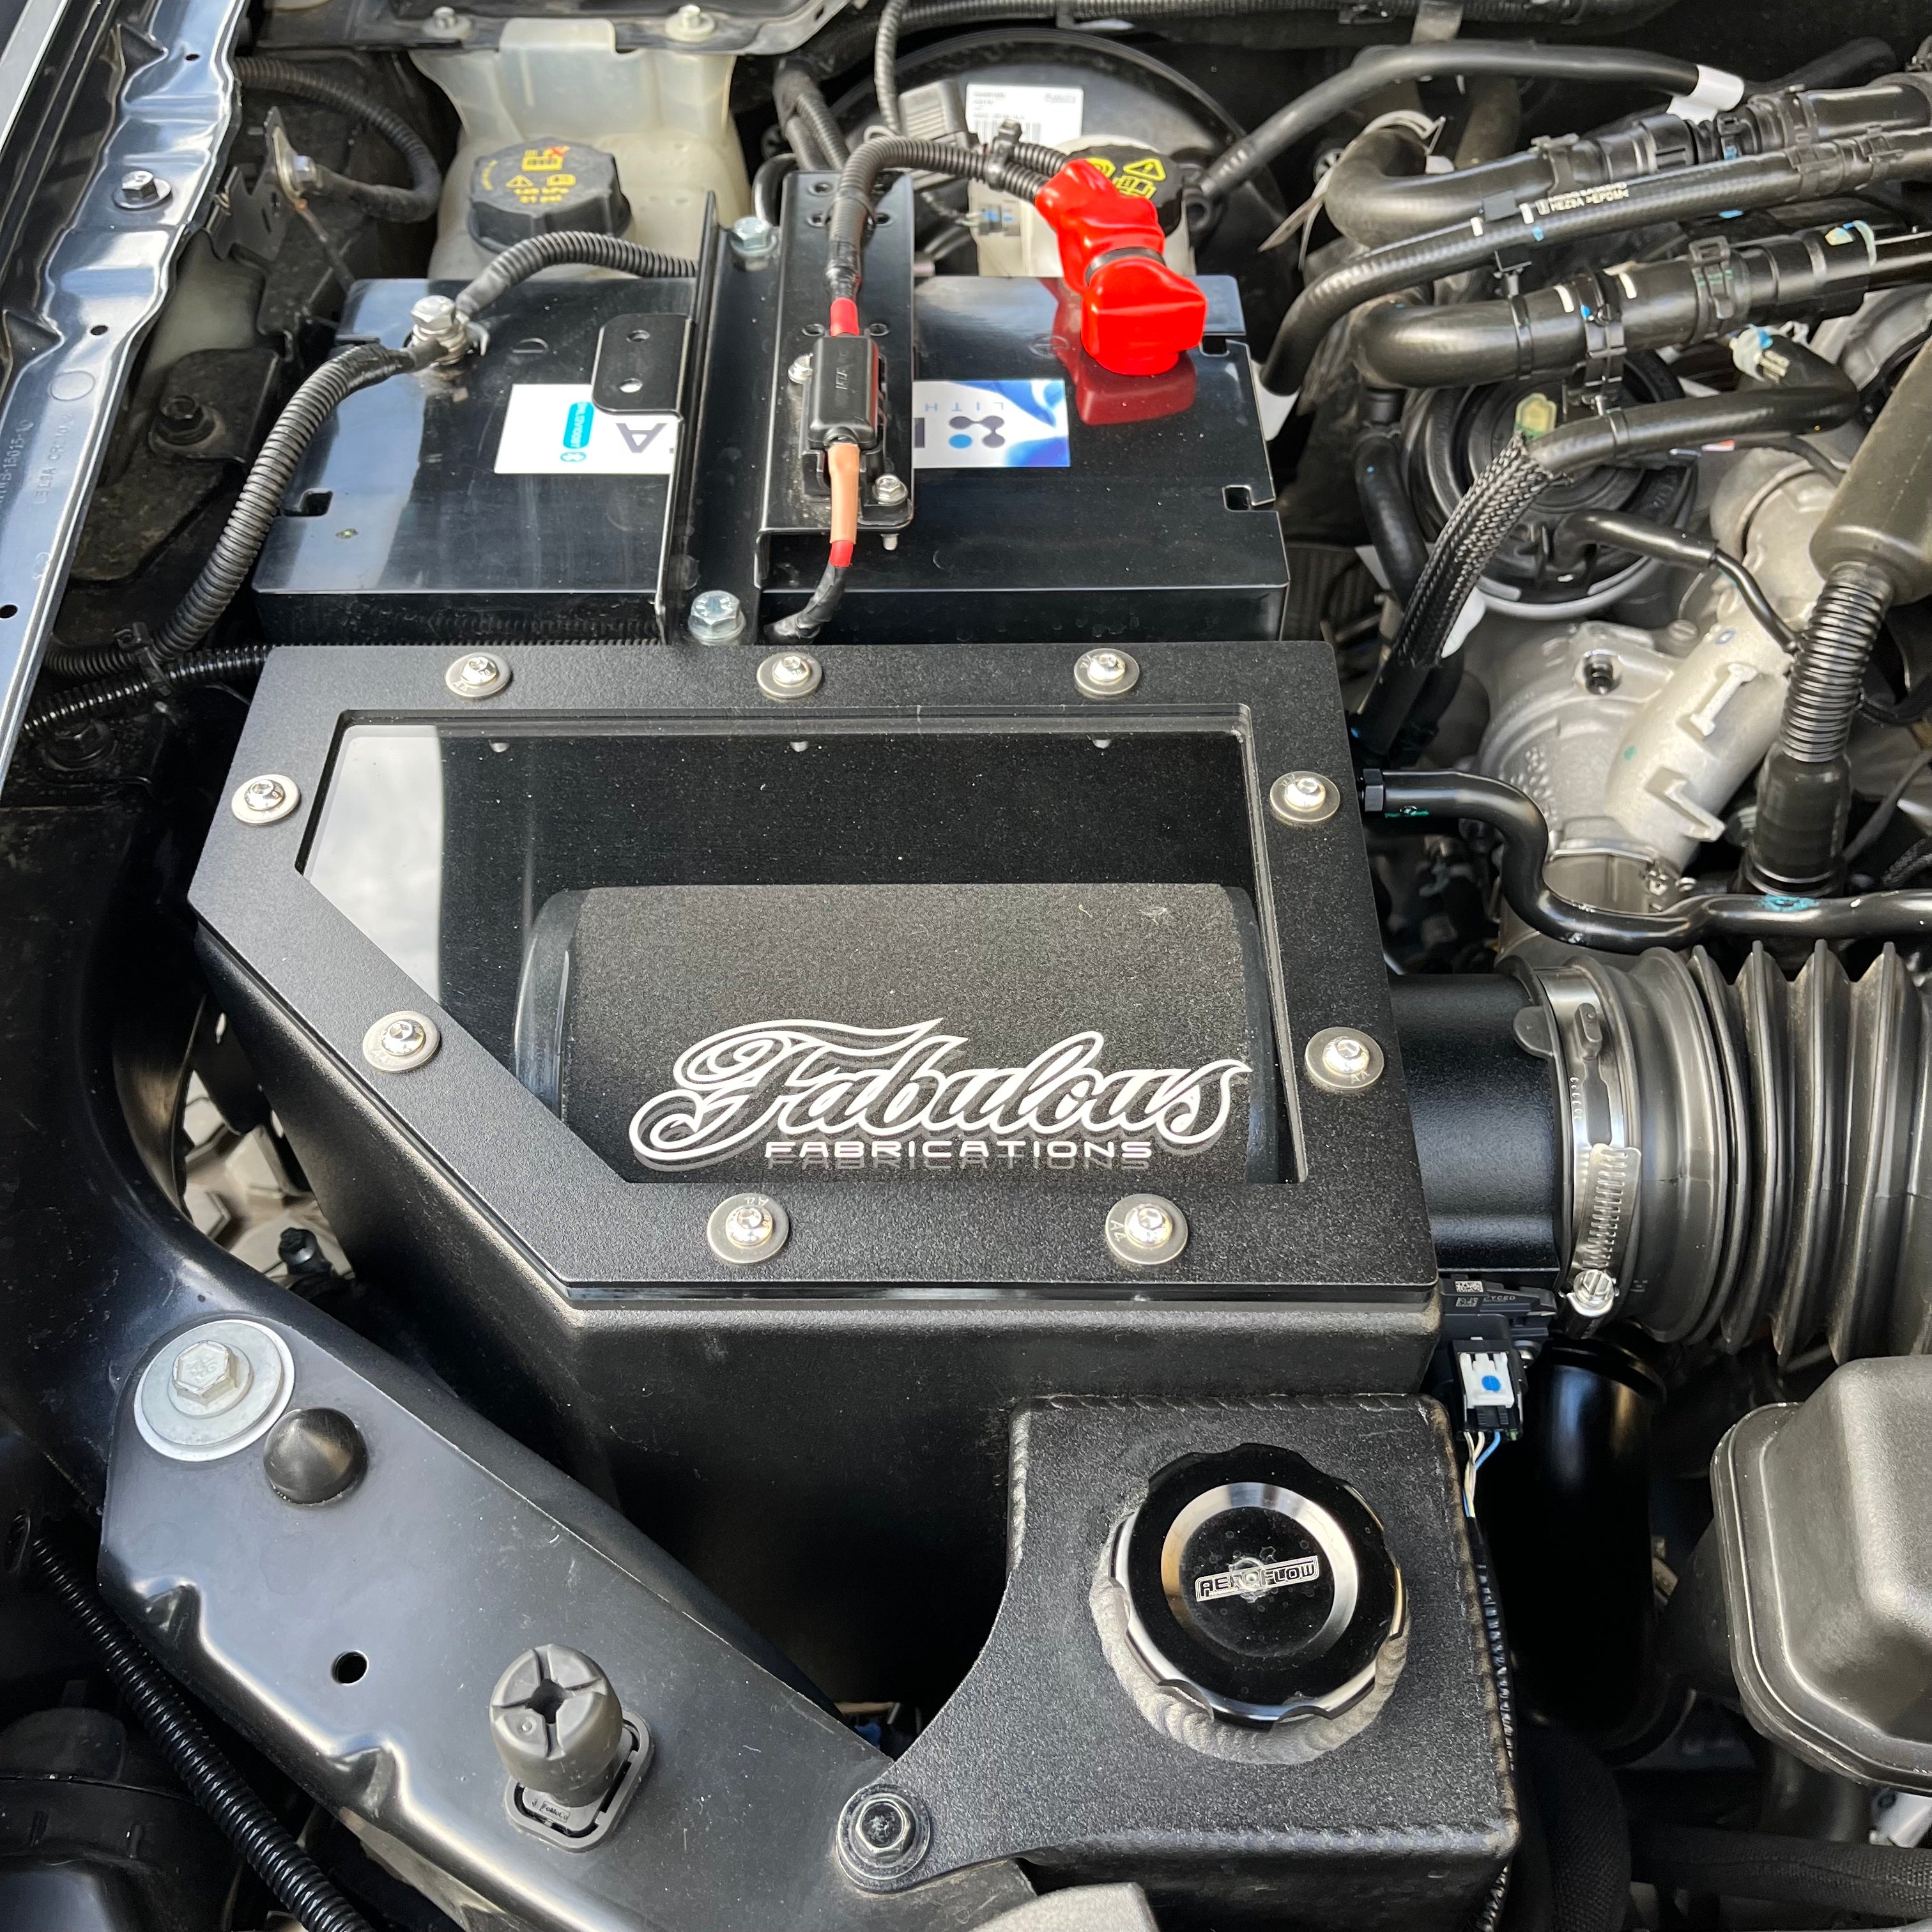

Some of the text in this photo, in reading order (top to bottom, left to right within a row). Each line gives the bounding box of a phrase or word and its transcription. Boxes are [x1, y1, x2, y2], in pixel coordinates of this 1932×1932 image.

[629, 1017, 1252, 1160] Fabulous
[764, 1140, 1152, 1158] FABRICATIONS
[1200, 1563, 1315, 1597] AEROFLOW
